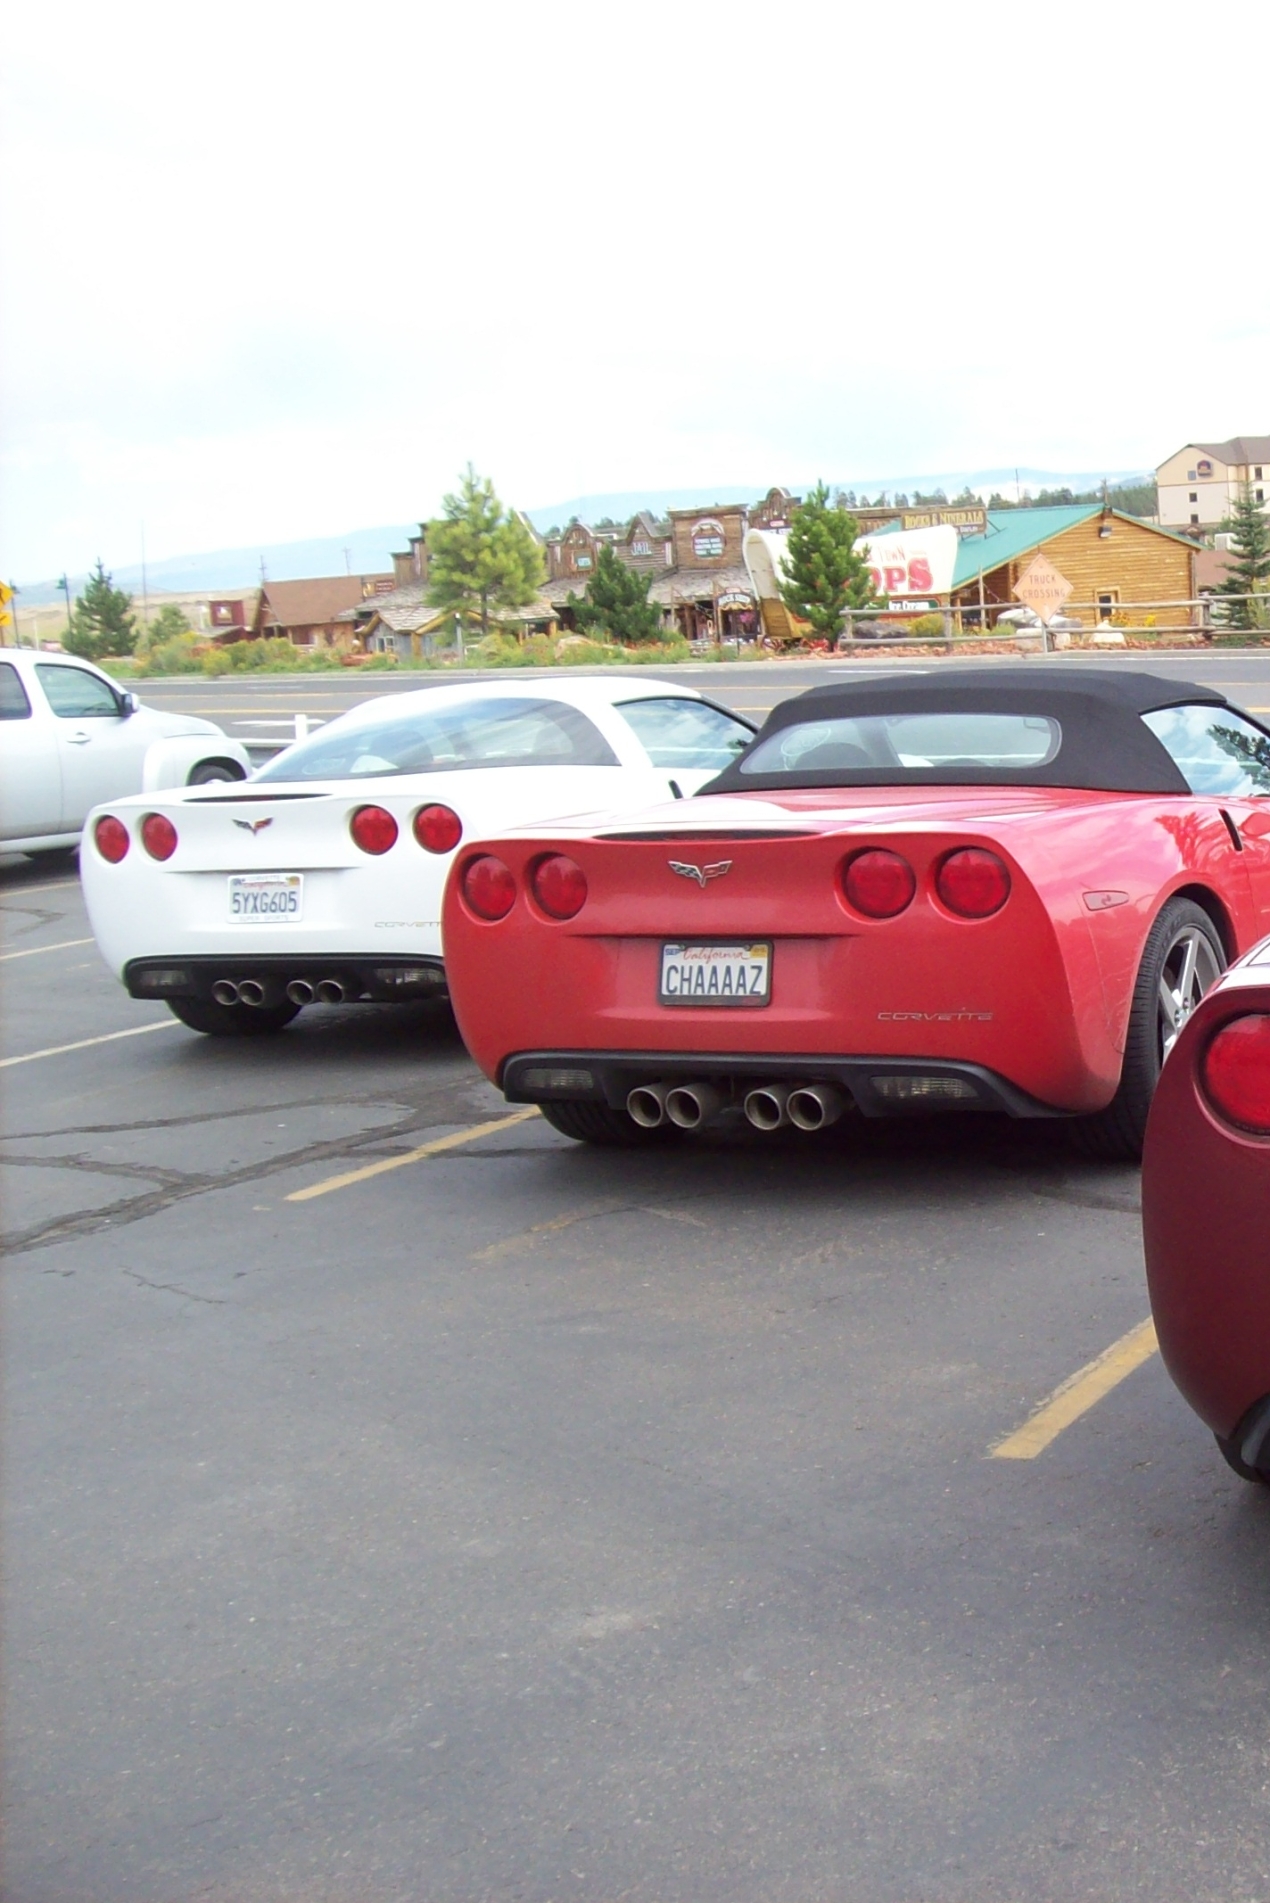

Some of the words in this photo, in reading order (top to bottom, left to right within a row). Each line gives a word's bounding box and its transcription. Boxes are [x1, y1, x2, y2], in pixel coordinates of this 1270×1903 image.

[1029, 573, 1056, 585] TRUCK
[1022, 588, 1066, 599] CROSSING
[232, 890, 298, 914] 5YXG605
[374, 921, 441, 929] CORVETT
[682, 947, 751, 965] California
[666, 965, 763, 996] CHAAAAZ
[877, 1010, 994, 1021] CORVETTE
